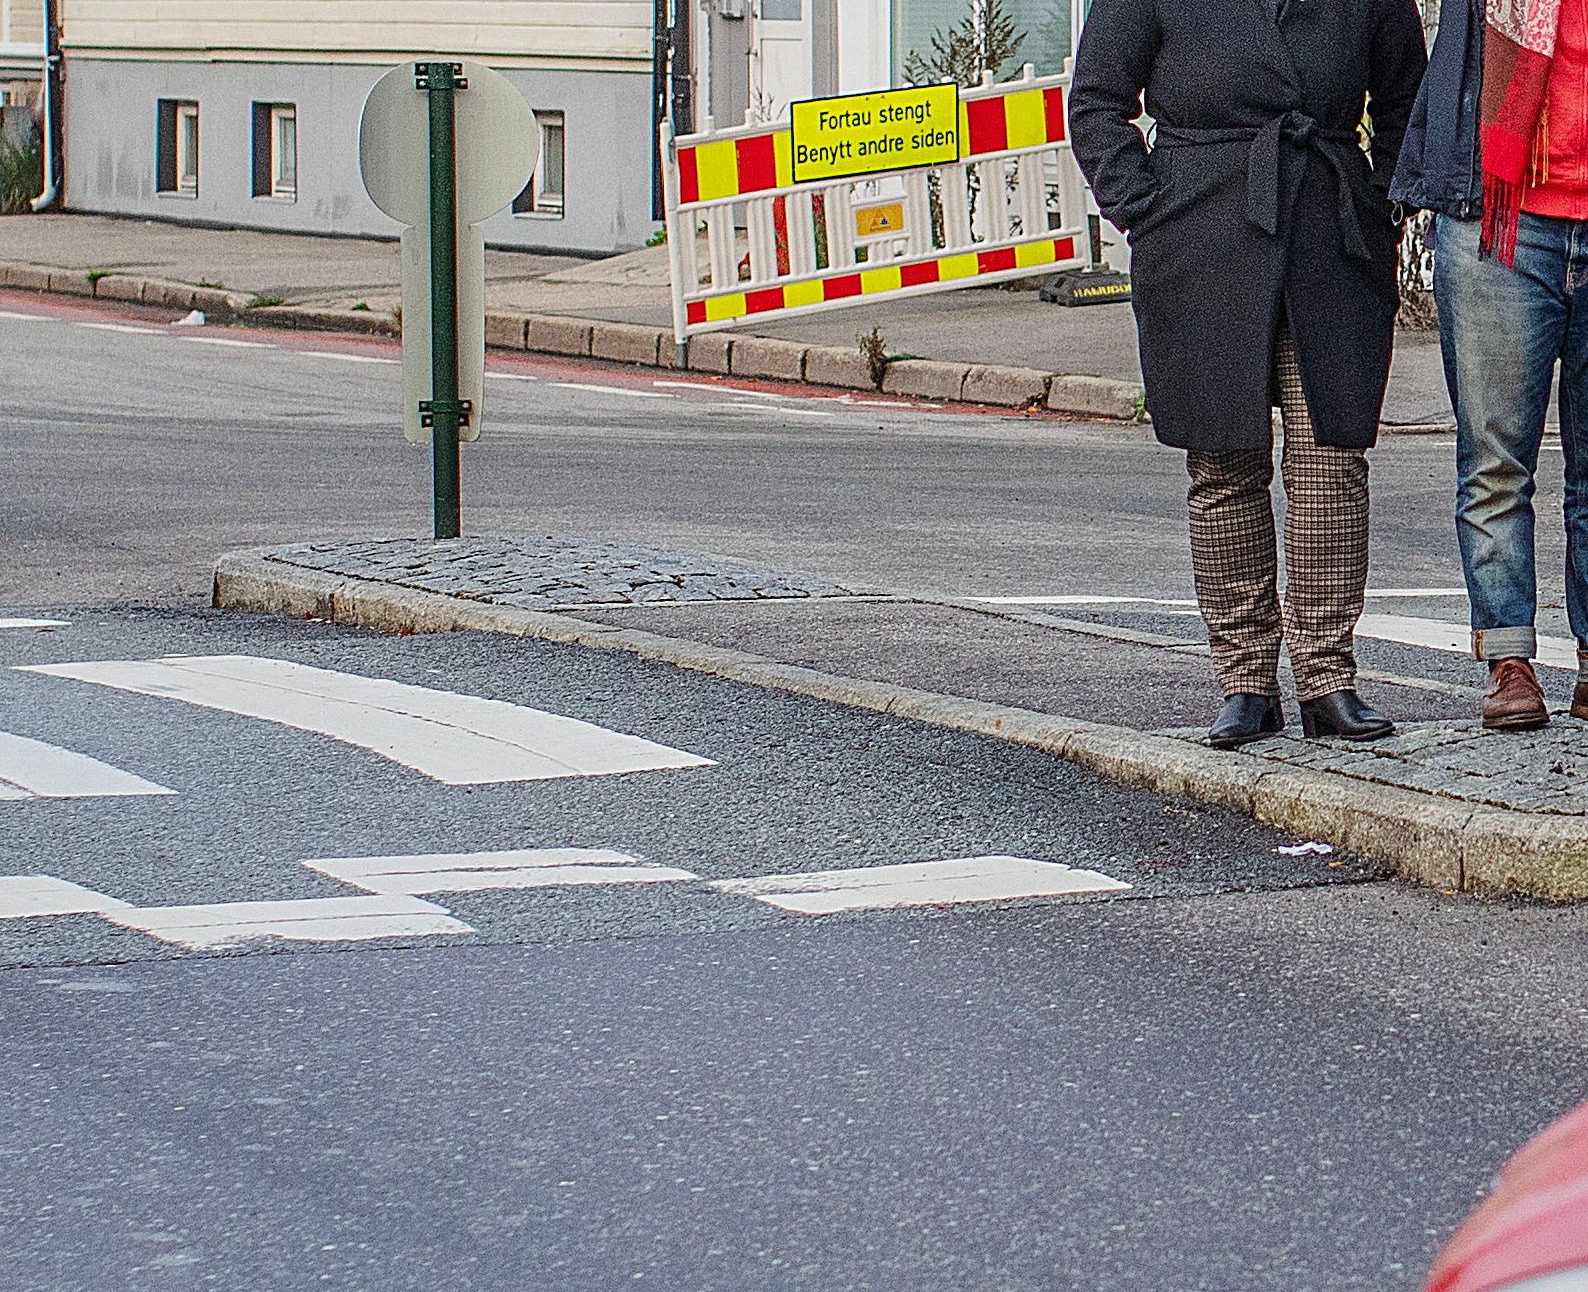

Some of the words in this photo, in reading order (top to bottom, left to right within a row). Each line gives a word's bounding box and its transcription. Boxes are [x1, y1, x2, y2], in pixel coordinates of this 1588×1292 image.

[819, 110, 872, 132] Fortau
[879, 100, 932, 124] stengt
[796, 140, 853, 166] Benytt
[857, 134, 904, 156] andre
[911, 128, 956, 150] siden
